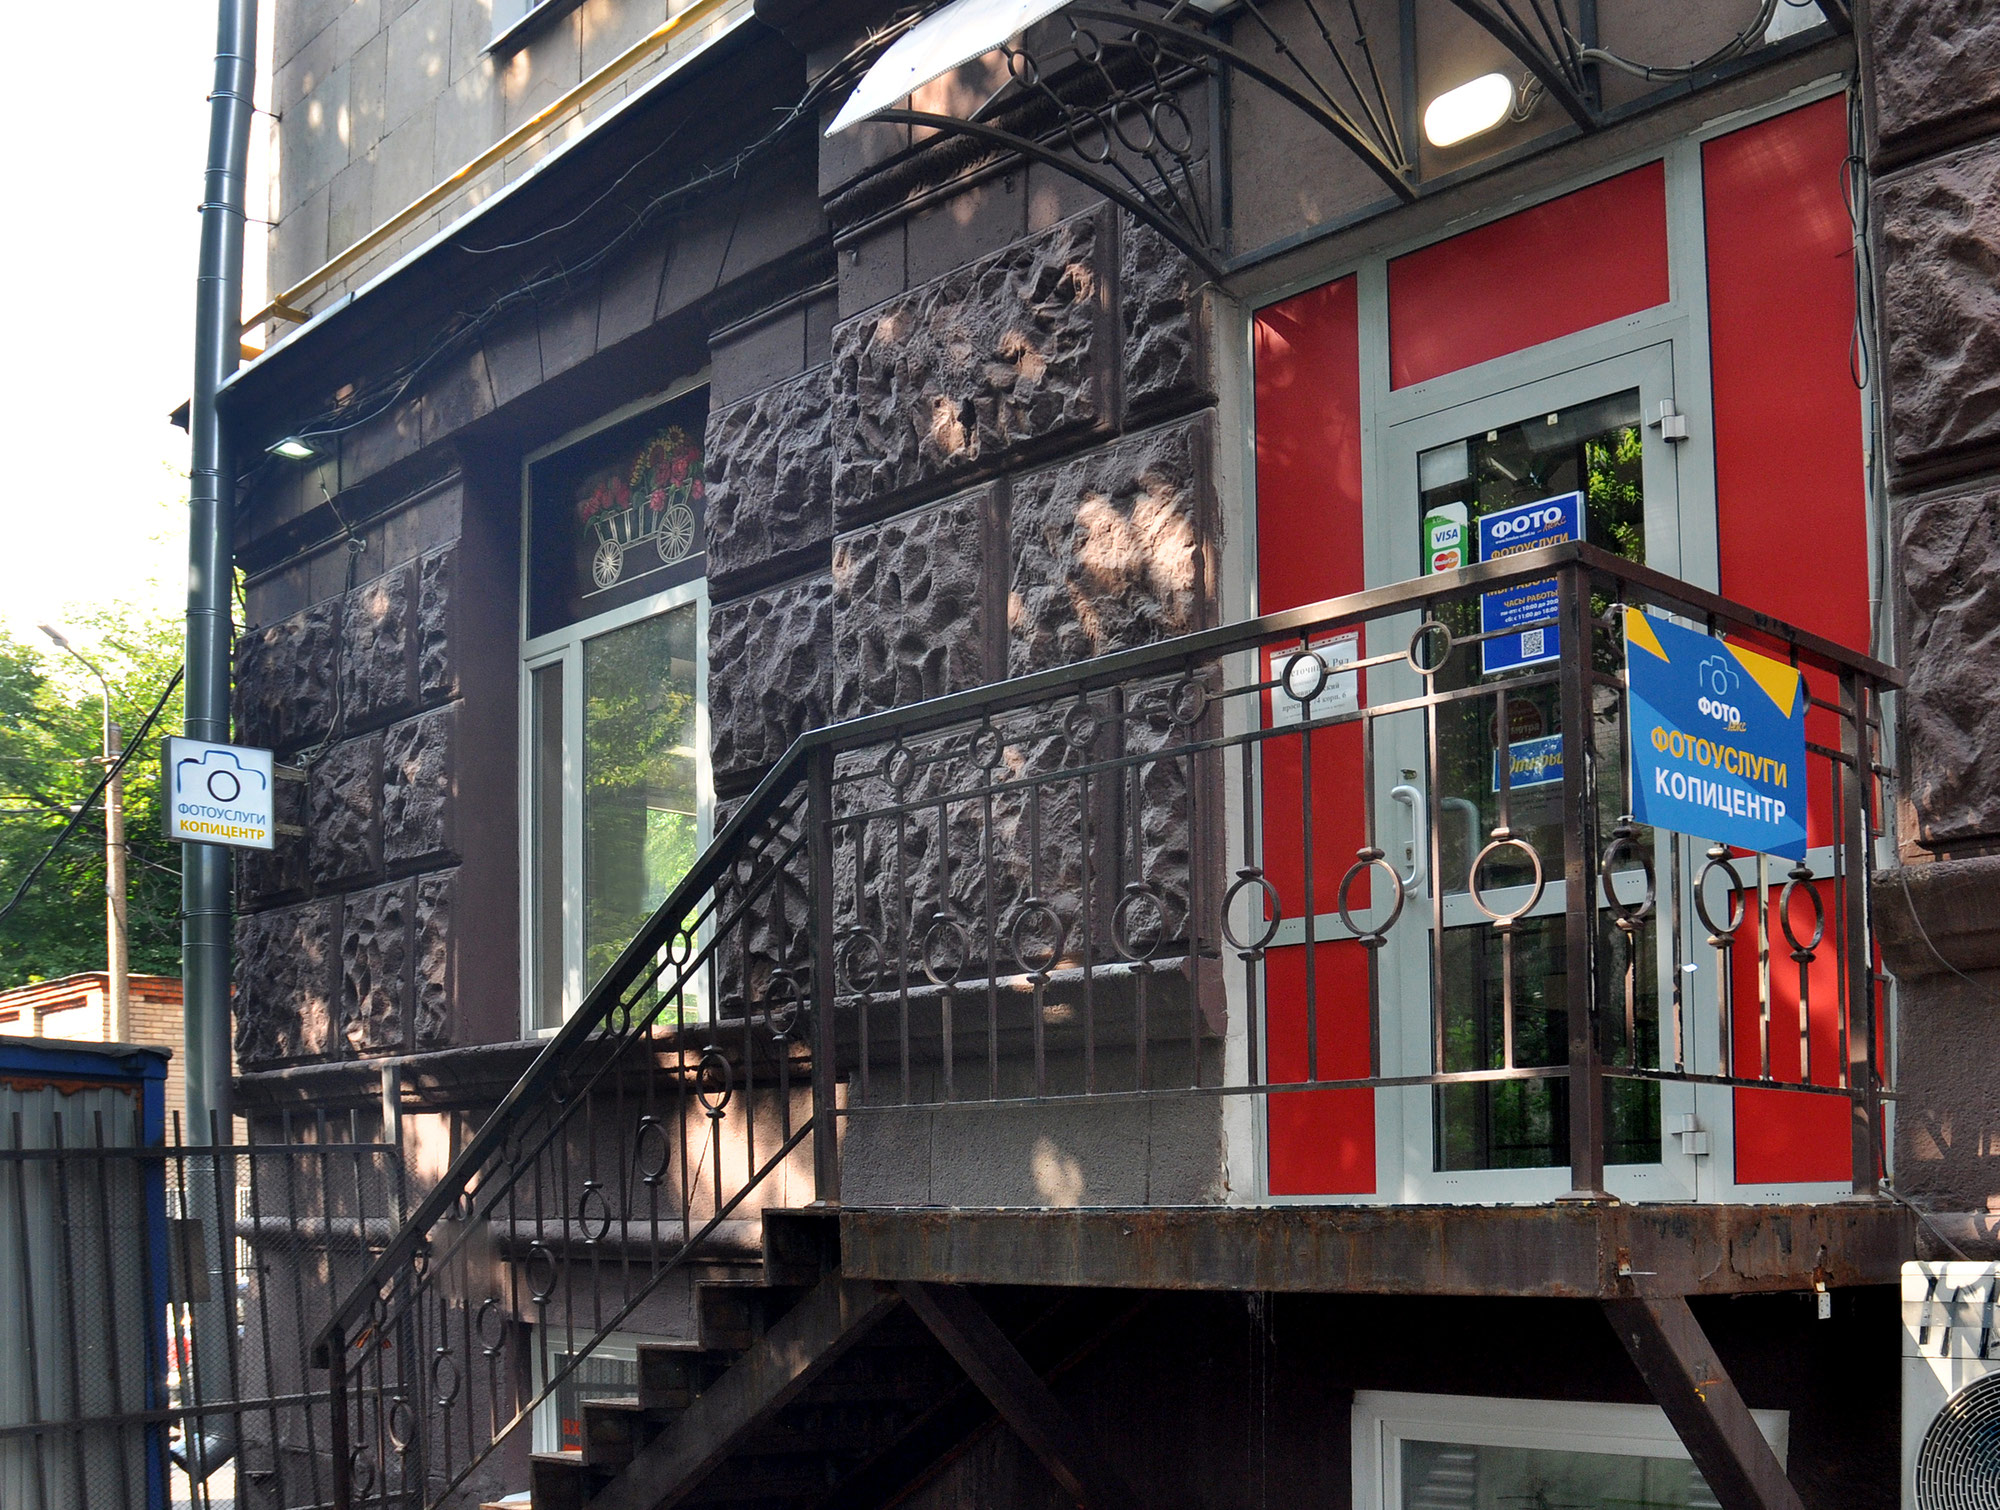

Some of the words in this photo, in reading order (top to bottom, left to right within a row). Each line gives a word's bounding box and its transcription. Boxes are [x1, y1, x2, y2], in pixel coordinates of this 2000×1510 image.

[1491, 506, 1562, 538] ФОТО
[1434, 528, 1459, 543] VISA
[1491, 531, 1569, 559] ФОТОУСЛУГИ
[1503, 597, 1525, 608] ЧАСЫ
[1526, 589, 1558, 603] РАБОТЫ
[1546, 598, 1559, 606] 20:0
[1698, 696, 1740, 723] ФОТО
[1651, 725, 1788, 788] ФОТОУСЛУГИ
[1655, 766, 1786, 825] КОПИЦЕНТР
[178, 803, 266, 825] ФОТОУСЛУГИ
[180, 819, 265, 840] КОПИЦЕНТР
